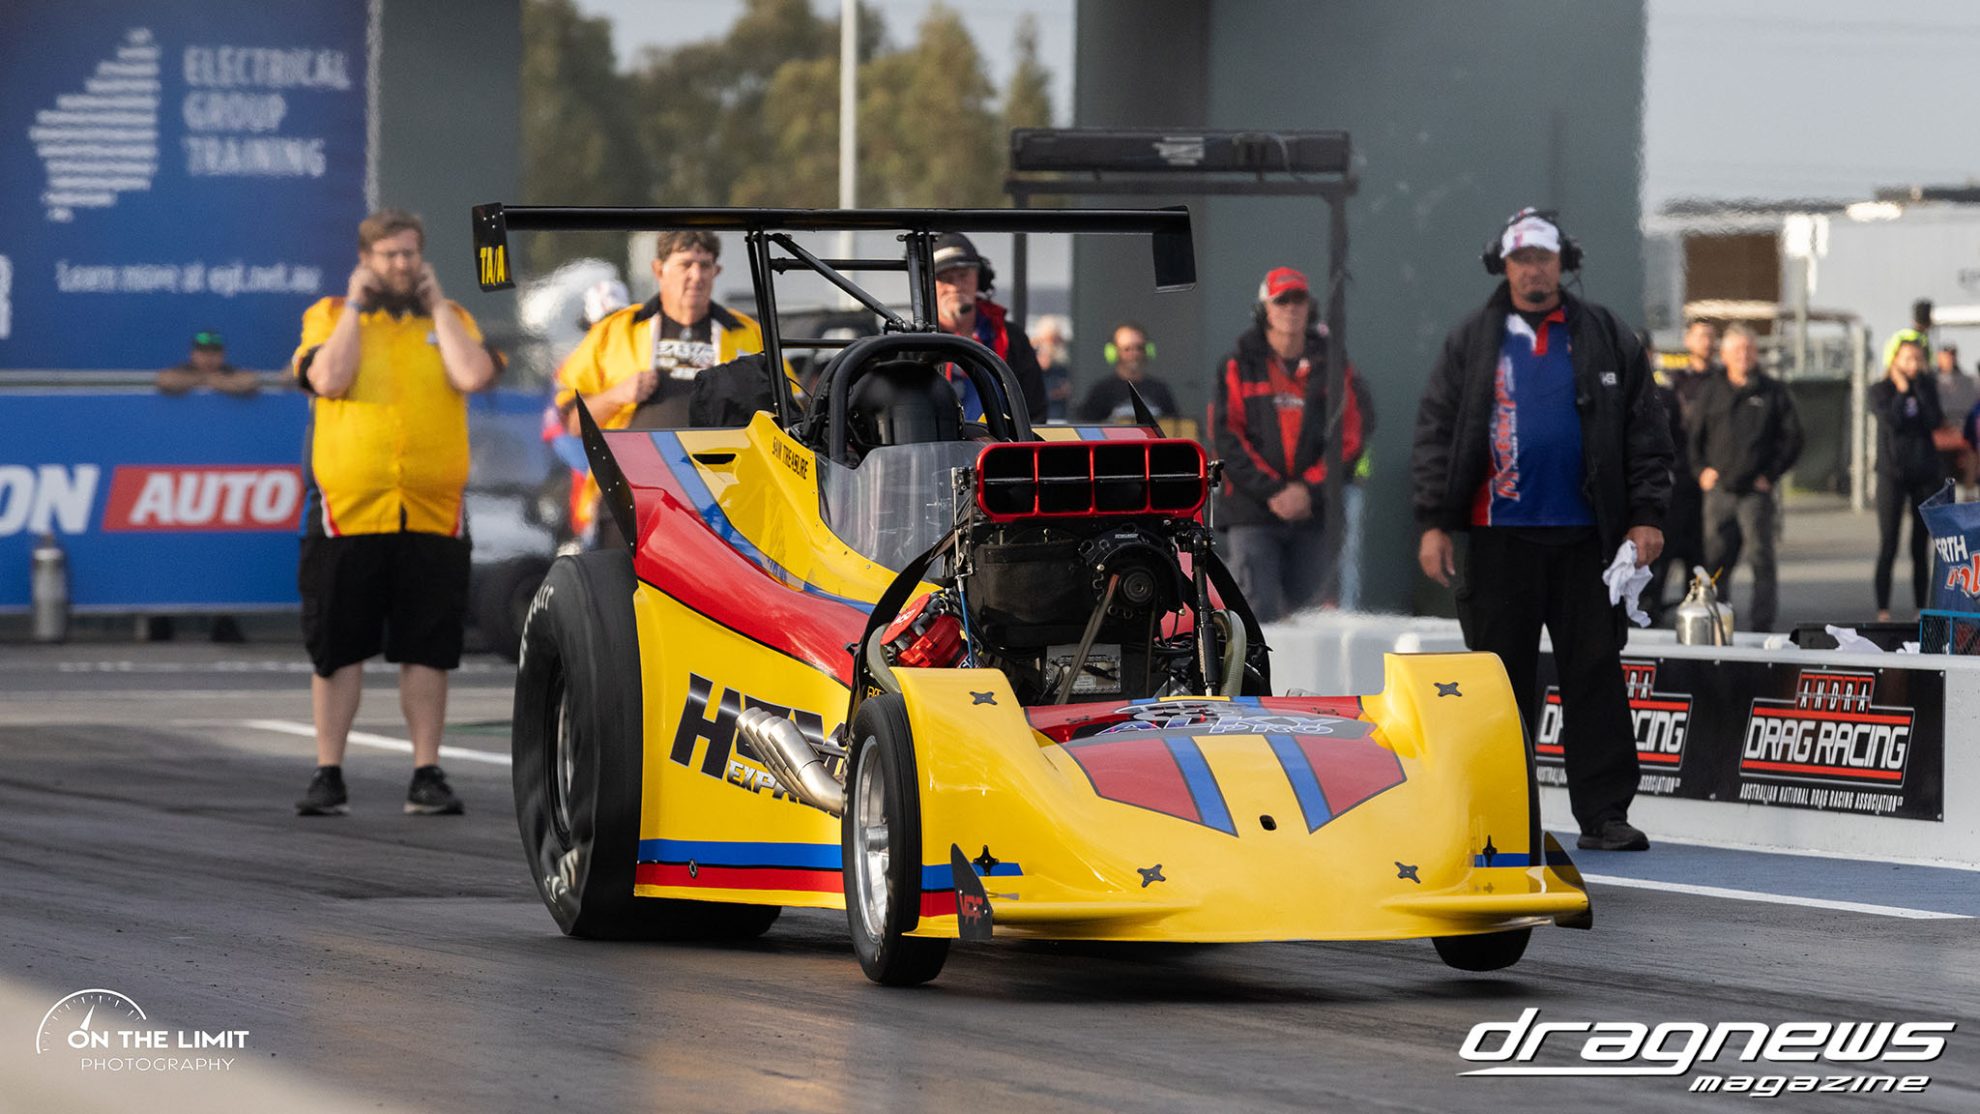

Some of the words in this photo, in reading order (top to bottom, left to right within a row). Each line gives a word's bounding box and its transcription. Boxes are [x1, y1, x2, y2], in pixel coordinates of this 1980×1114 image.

[183, 46, 351, 90] ELECTRICAL
[182, 91, 287, 132] GROUP
[182, 136, 326, 177] TRAINING
[56, 259, 115, 293] Learn
[119, 263, 178, 293] more
[480, 245, 505, 286] TA/A
[129, 470, 298, 525] AUTO
[1799, 680, 1868, 712] ANDRA
[1744, 717, 1816, 763] DRAG
[1814, 721, 1909, 770] RACING
[1739, 782, 1778, 802] AUSTRALIAN
[1778, 786, 1809, 805] NATIONAL
[1810, 788, 1828, 807] DRAG
[1828, 790, 1854, 809] RACING
[1854, 792, 1897, 813] ASSOCIATION
